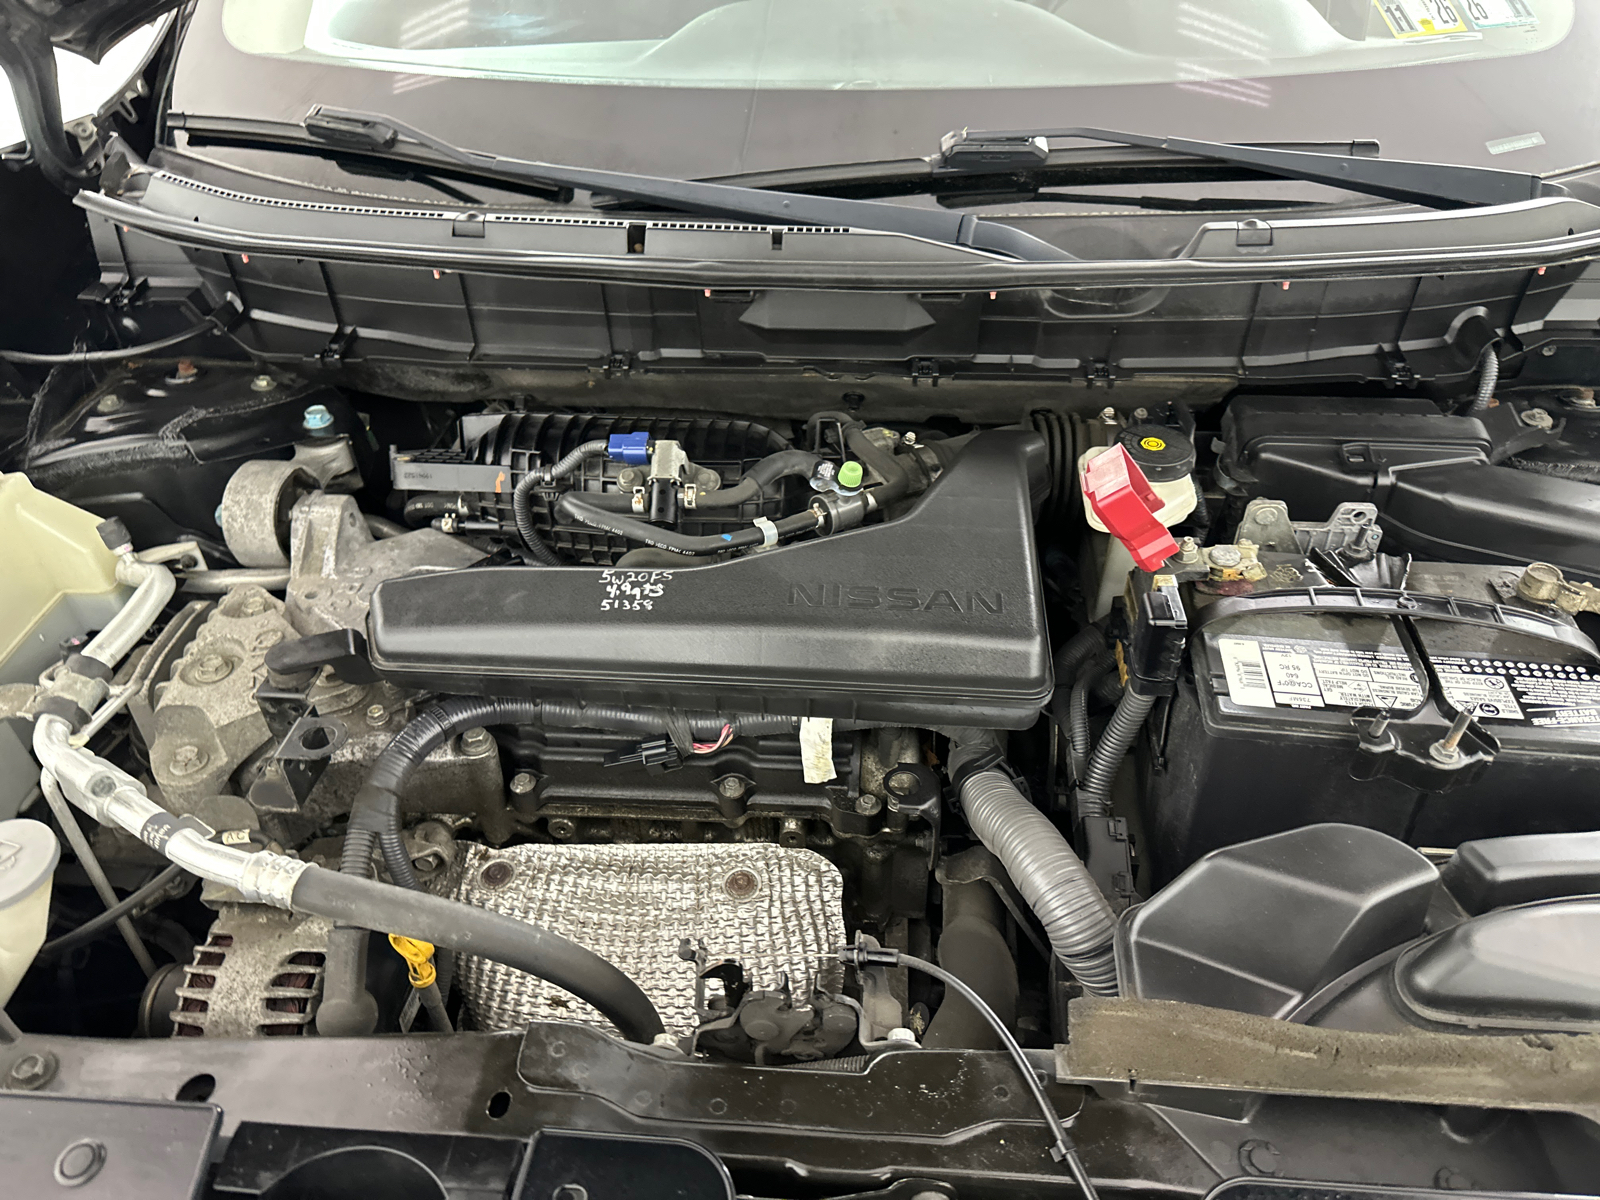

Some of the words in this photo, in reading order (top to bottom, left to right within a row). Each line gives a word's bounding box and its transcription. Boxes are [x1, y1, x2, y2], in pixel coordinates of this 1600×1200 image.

[1385, 5, 1415, 31] 11
[1429, 0, 1458, 24] 26
[1466, 0, 1489, 20] 26
[600, 599, 654, 611] 51358
[786, 583, 1004, 615] NISSAN
[1556, 709, 1598, 717] BATTERY
